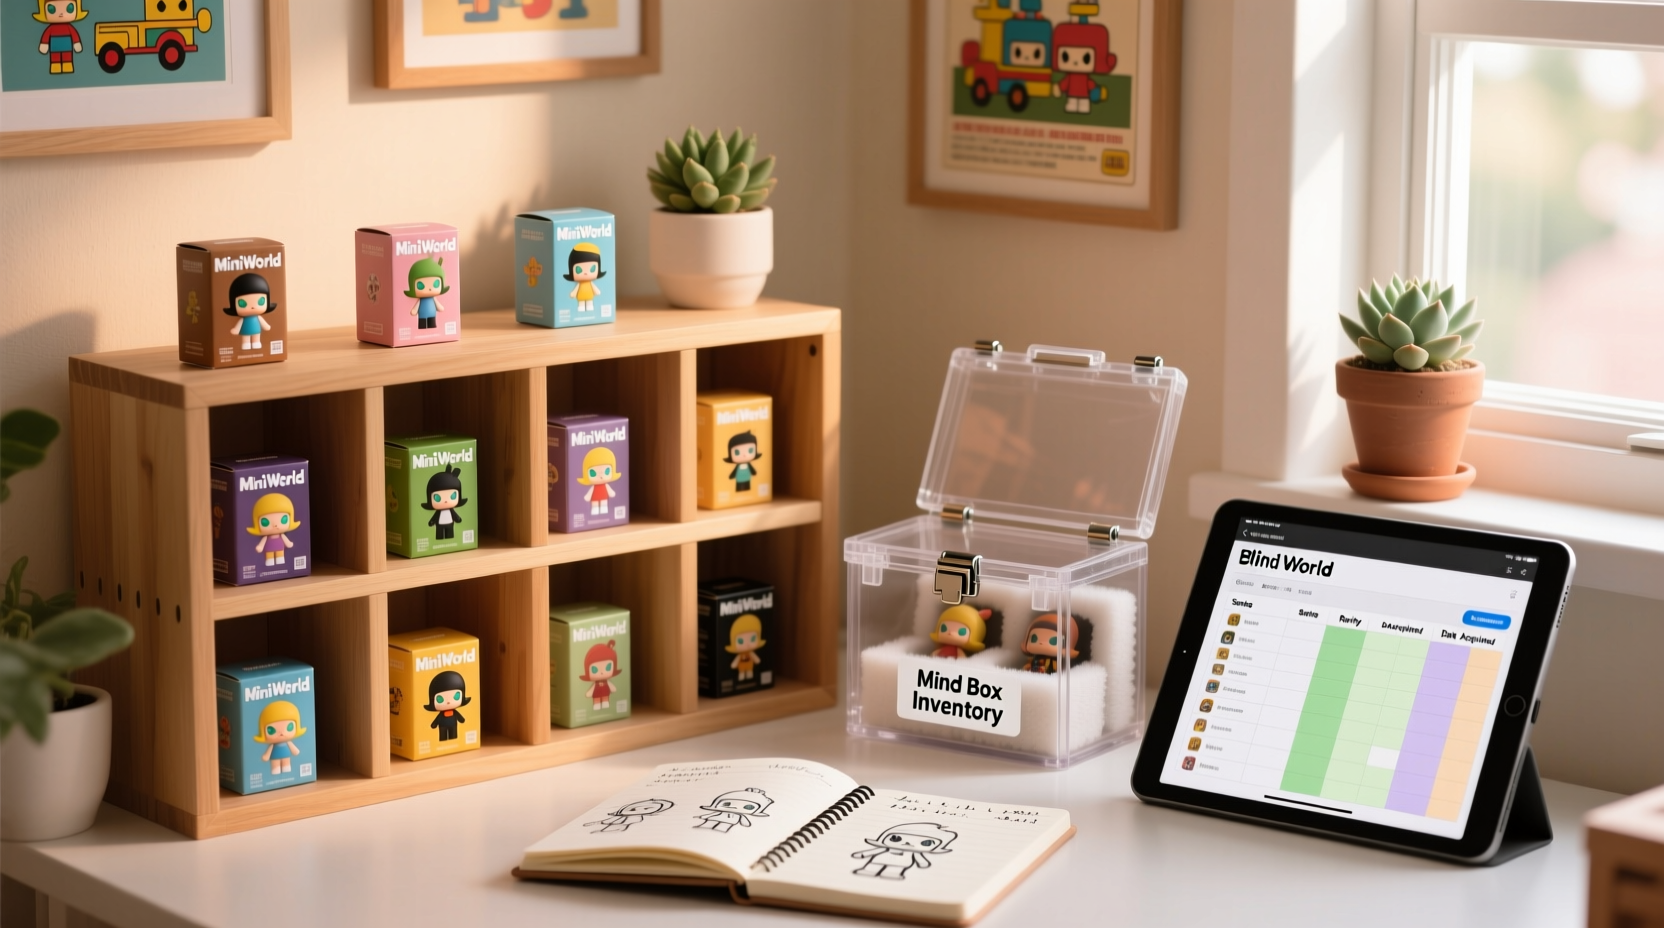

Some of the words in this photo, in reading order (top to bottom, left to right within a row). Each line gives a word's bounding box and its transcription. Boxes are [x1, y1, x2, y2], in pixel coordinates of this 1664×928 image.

[395, 237, 456, 256] MiniWorld
[214, 252, 282, 272] MiniWorld
[571, 425, 626, 447] MiniWorld
[412, 447, 473, 470] MiniWorld
[1239, 548, 1281, 570] Blind
[1283, 553, 1335, 577] World
[415, 647, 476, 672] MiniWorld
[244, 676, 310, 702] MiniWorld
[917, 669, 963, 693] Mind
[967, 677, 1003, 701] Box
[912, 690, 1004, 728] Inventory
